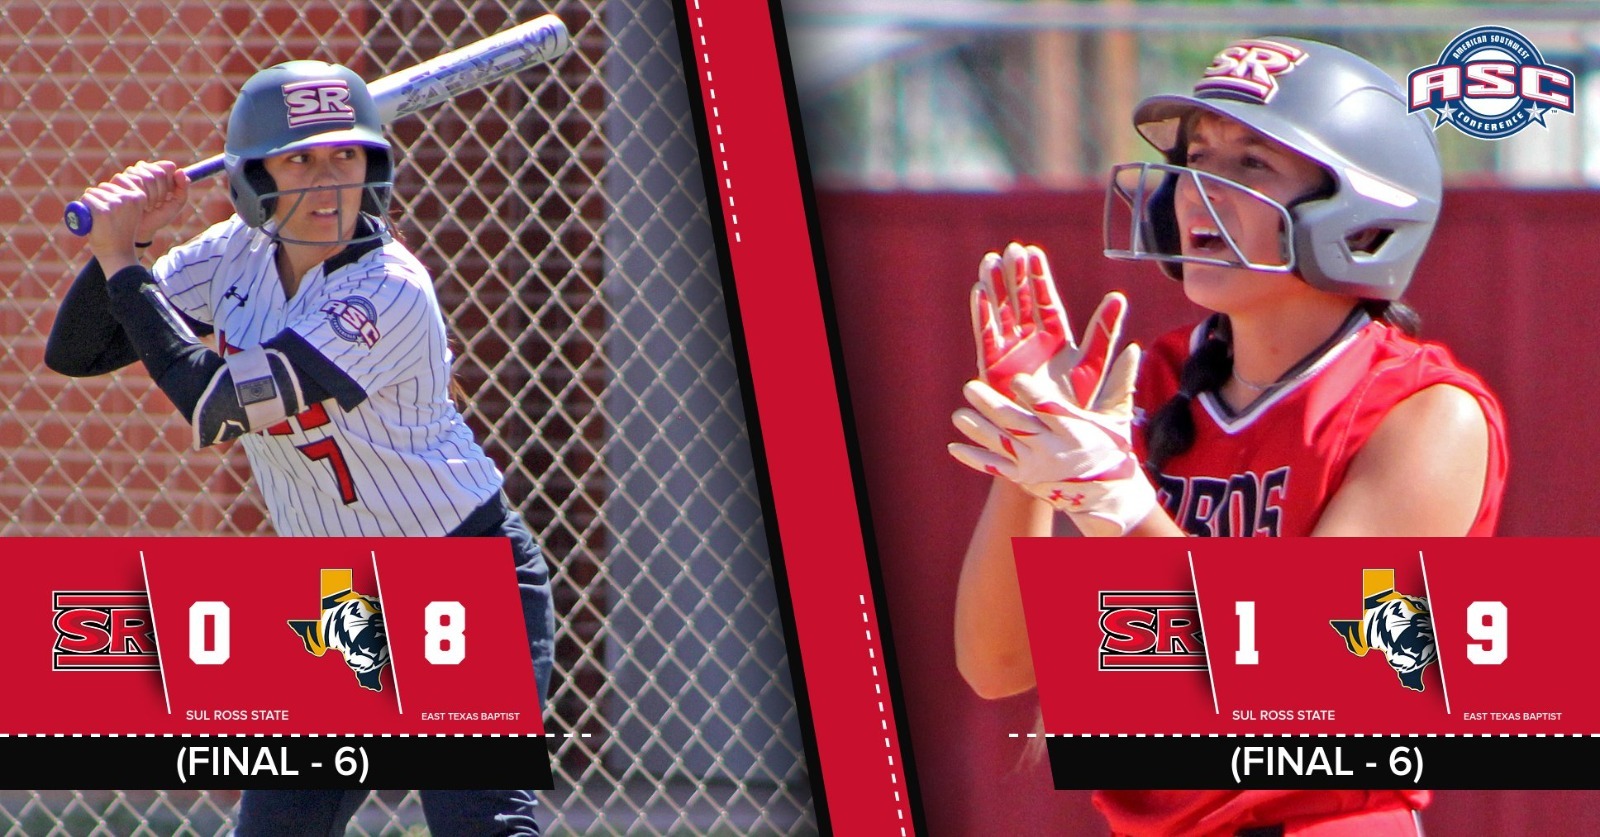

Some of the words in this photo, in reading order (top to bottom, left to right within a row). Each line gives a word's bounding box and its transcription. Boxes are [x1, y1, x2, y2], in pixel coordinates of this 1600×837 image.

[1202, 44, 1294, 90] SR
[284, 85, 355, 117] SR
[319, 299, 381, 349] ASC
[296, 435, 358, 505] 7
[1157, 466, 1291, 537] BOS
